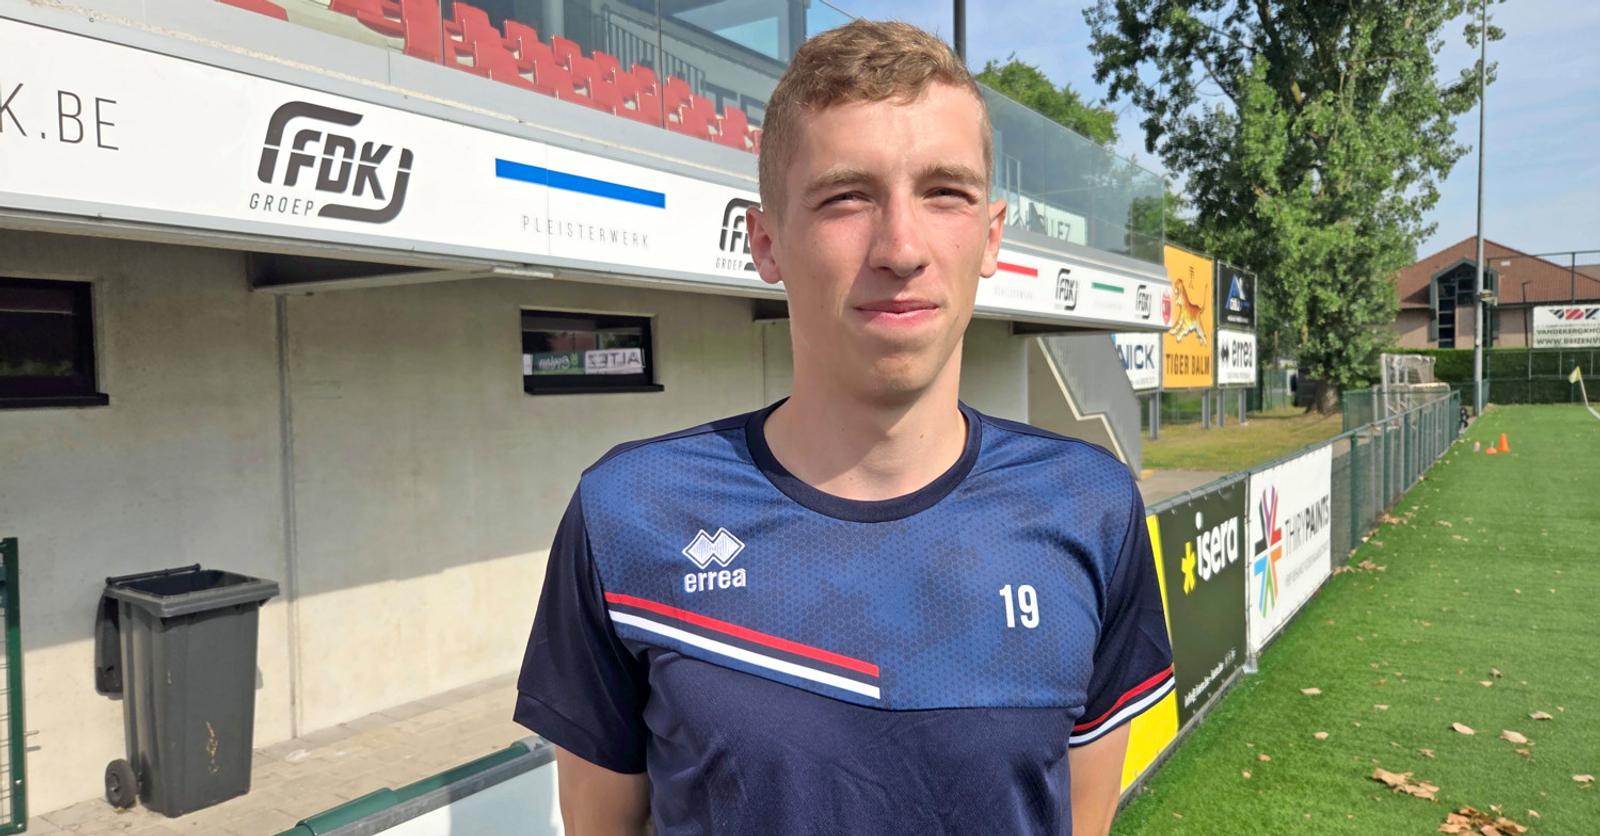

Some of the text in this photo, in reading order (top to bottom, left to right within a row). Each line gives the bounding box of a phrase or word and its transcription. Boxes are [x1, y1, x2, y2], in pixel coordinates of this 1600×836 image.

[249, 192, 314, 216] GROEP
[523, 214, 649, 249] PLEISTERWERK
[716, 257, 743, 271] GROEP
[1166, 353, 1210, 376] TIGER BALM
[1195, 511, 1239, 582] isera
[999, 584, 1040, 629] 19
